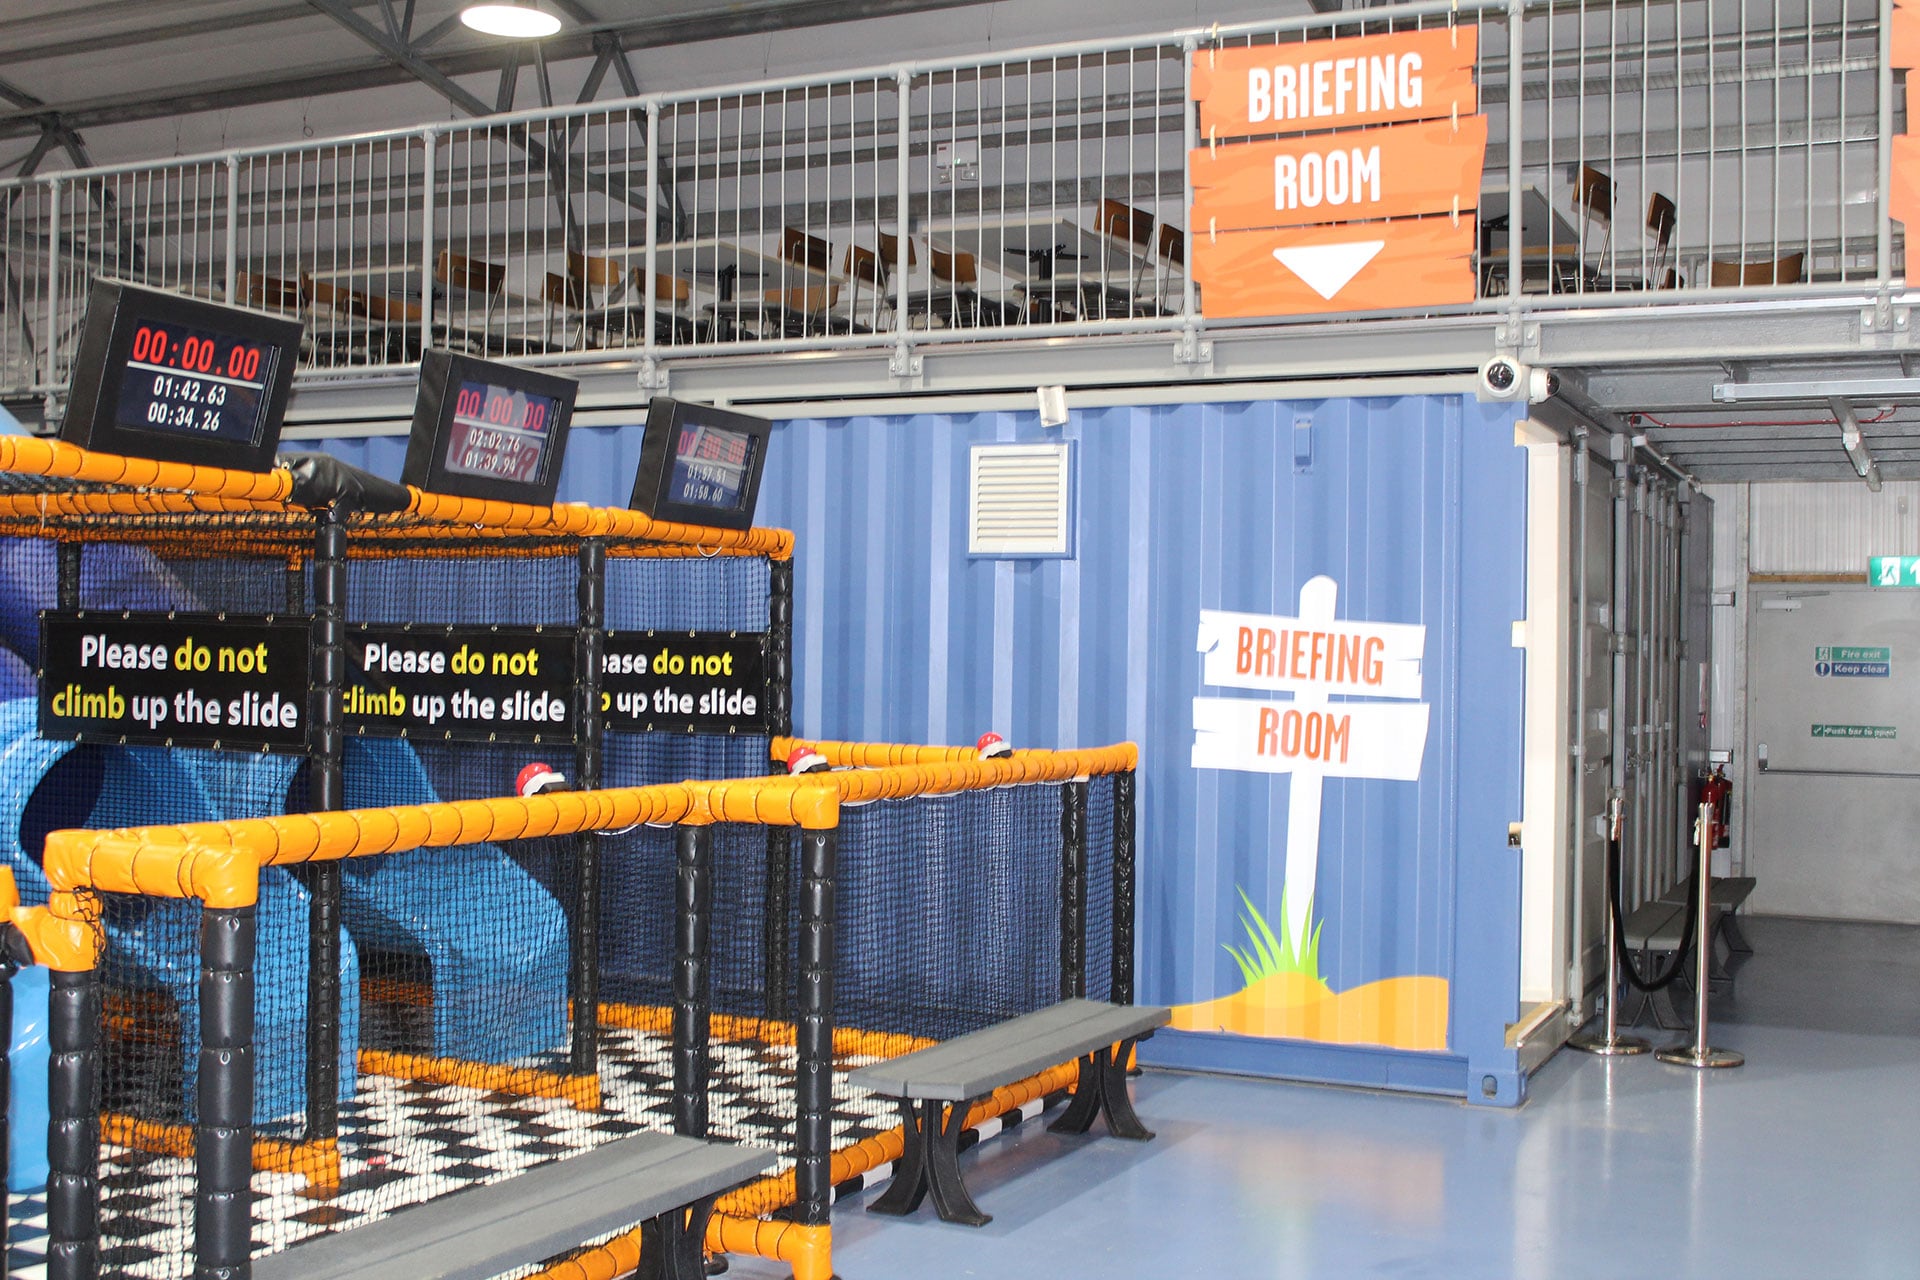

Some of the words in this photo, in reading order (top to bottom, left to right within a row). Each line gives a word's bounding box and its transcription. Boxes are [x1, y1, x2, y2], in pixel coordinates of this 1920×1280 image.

[1248, 52, 1423, 123] BRIEFING
[1274, 145, 1381, 211] ROOM
[132, 326, 260, 380] 00:00.00
[153, 375, 227, 406] 01:42.63
[457, 389, 545, 430] 00:00.00
[147, 402, 221, 432] 00:34.26
[81, 634, 168, 671] Please
[174, 636, 211, 672] do
[218, 642, 268, 674] not
[363, 642, 446, 674] Please
[451, 644, 485, 675] do
[492, 648, 539, 676] not
[653, 648, 685, 675] do
[690, 651, 733, 676] not
[1236, 626, 1385, 686] BRIEFING
[1834, 664, 1860, 675] Keep
[1862, 664, 1887, 673] clear
[1841, 650, 1860, 659] Fire
[1862, 651, 1881, 659] exit
[52, 683, 125, 720] climb
[132, 695, 167, 729] up
[174, 688, 221, 726] the
[228, 691, 298, 729] slide
[412, 694, 446, 725] up
[451, 688, 495, 720] the
[501, 689, 566, 722] slide
[617, 691, 648, 719] up
[653, 686, 694, 714] the
[699, 687, 757, 716] slide
[1257, 707, 1351, 764] ROOM
